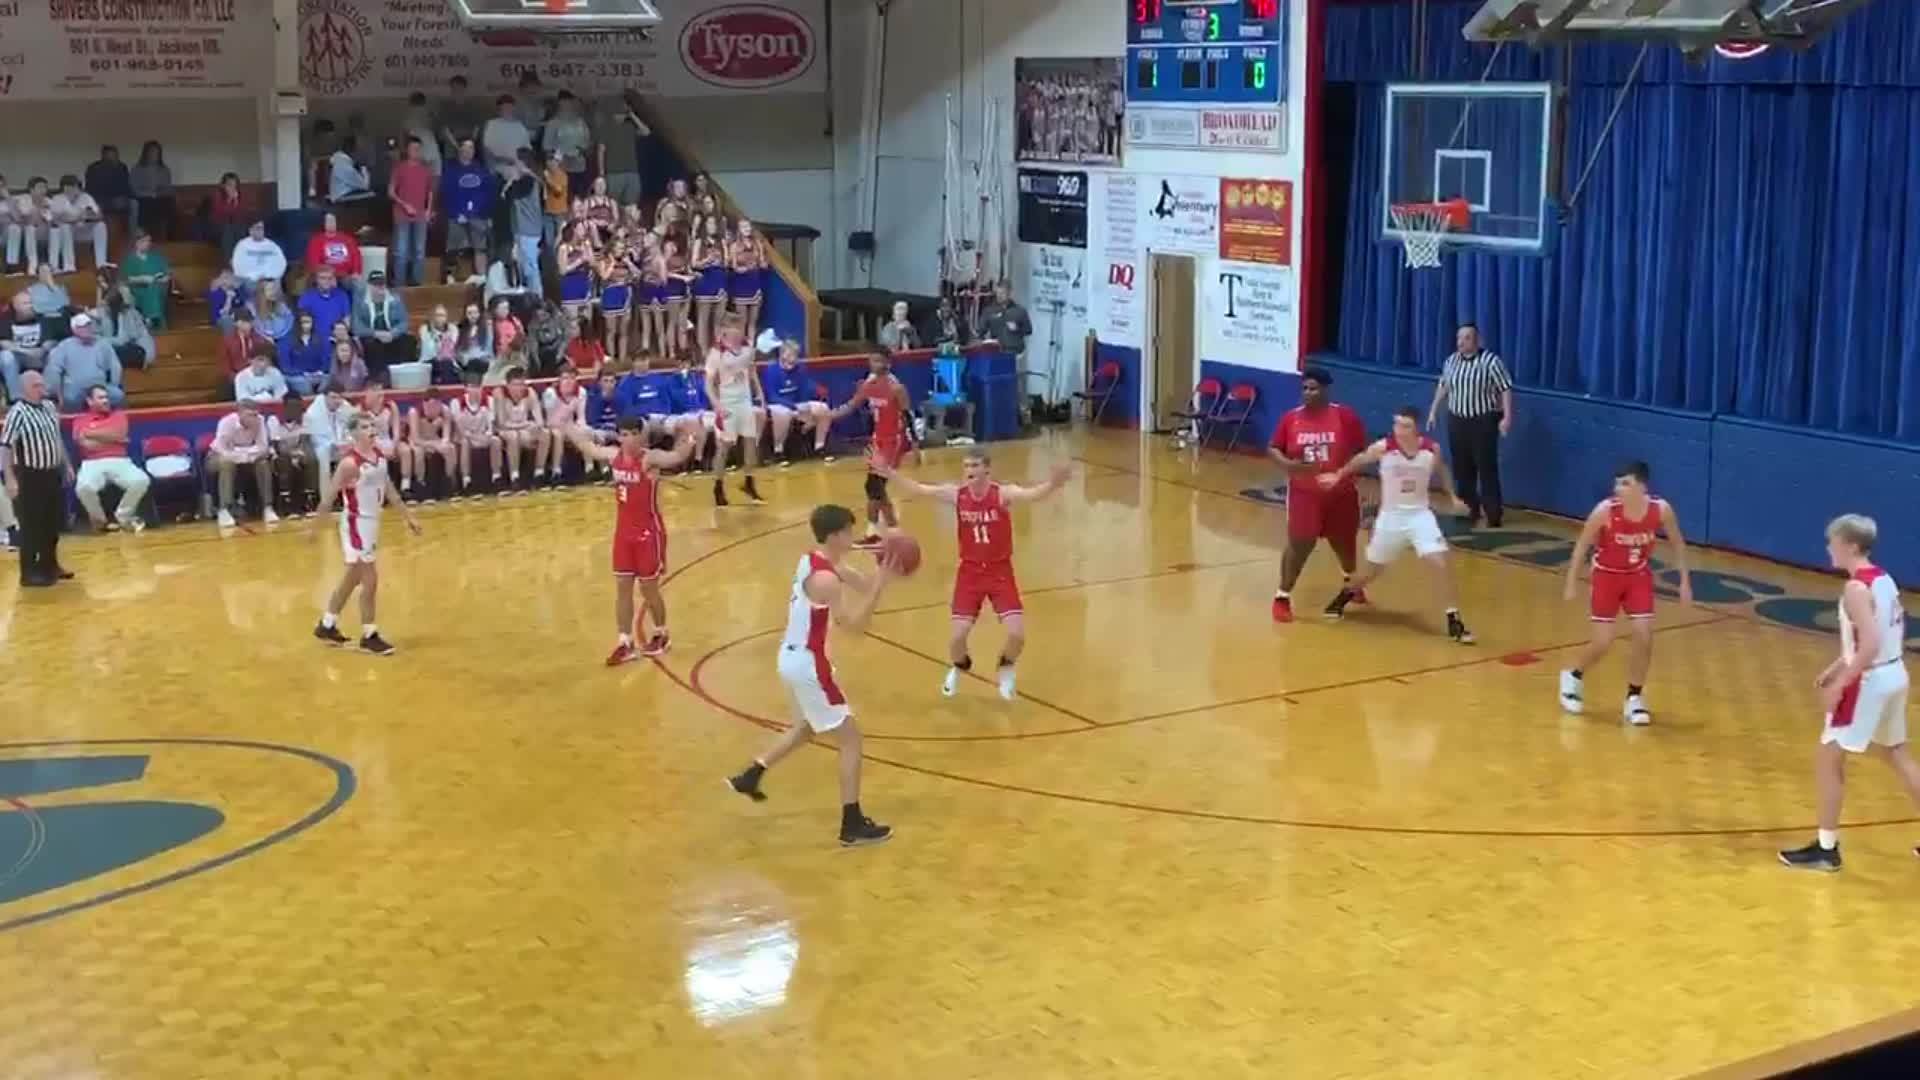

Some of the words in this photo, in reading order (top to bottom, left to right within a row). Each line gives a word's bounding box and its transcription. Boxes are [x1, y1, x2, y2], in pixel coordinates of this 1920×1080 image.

[102, 0, 191, 21] CONSTRUCTION
[1207, 12, 1220, 41] 3
[692, 22, 802, 70] Tyson
[1253, 61, 1265, 89] 0
[1108, 263, 1135, 291] DQ
[1302, 444, 1330, 463] 54
[972, 525, 991, 544] 11
